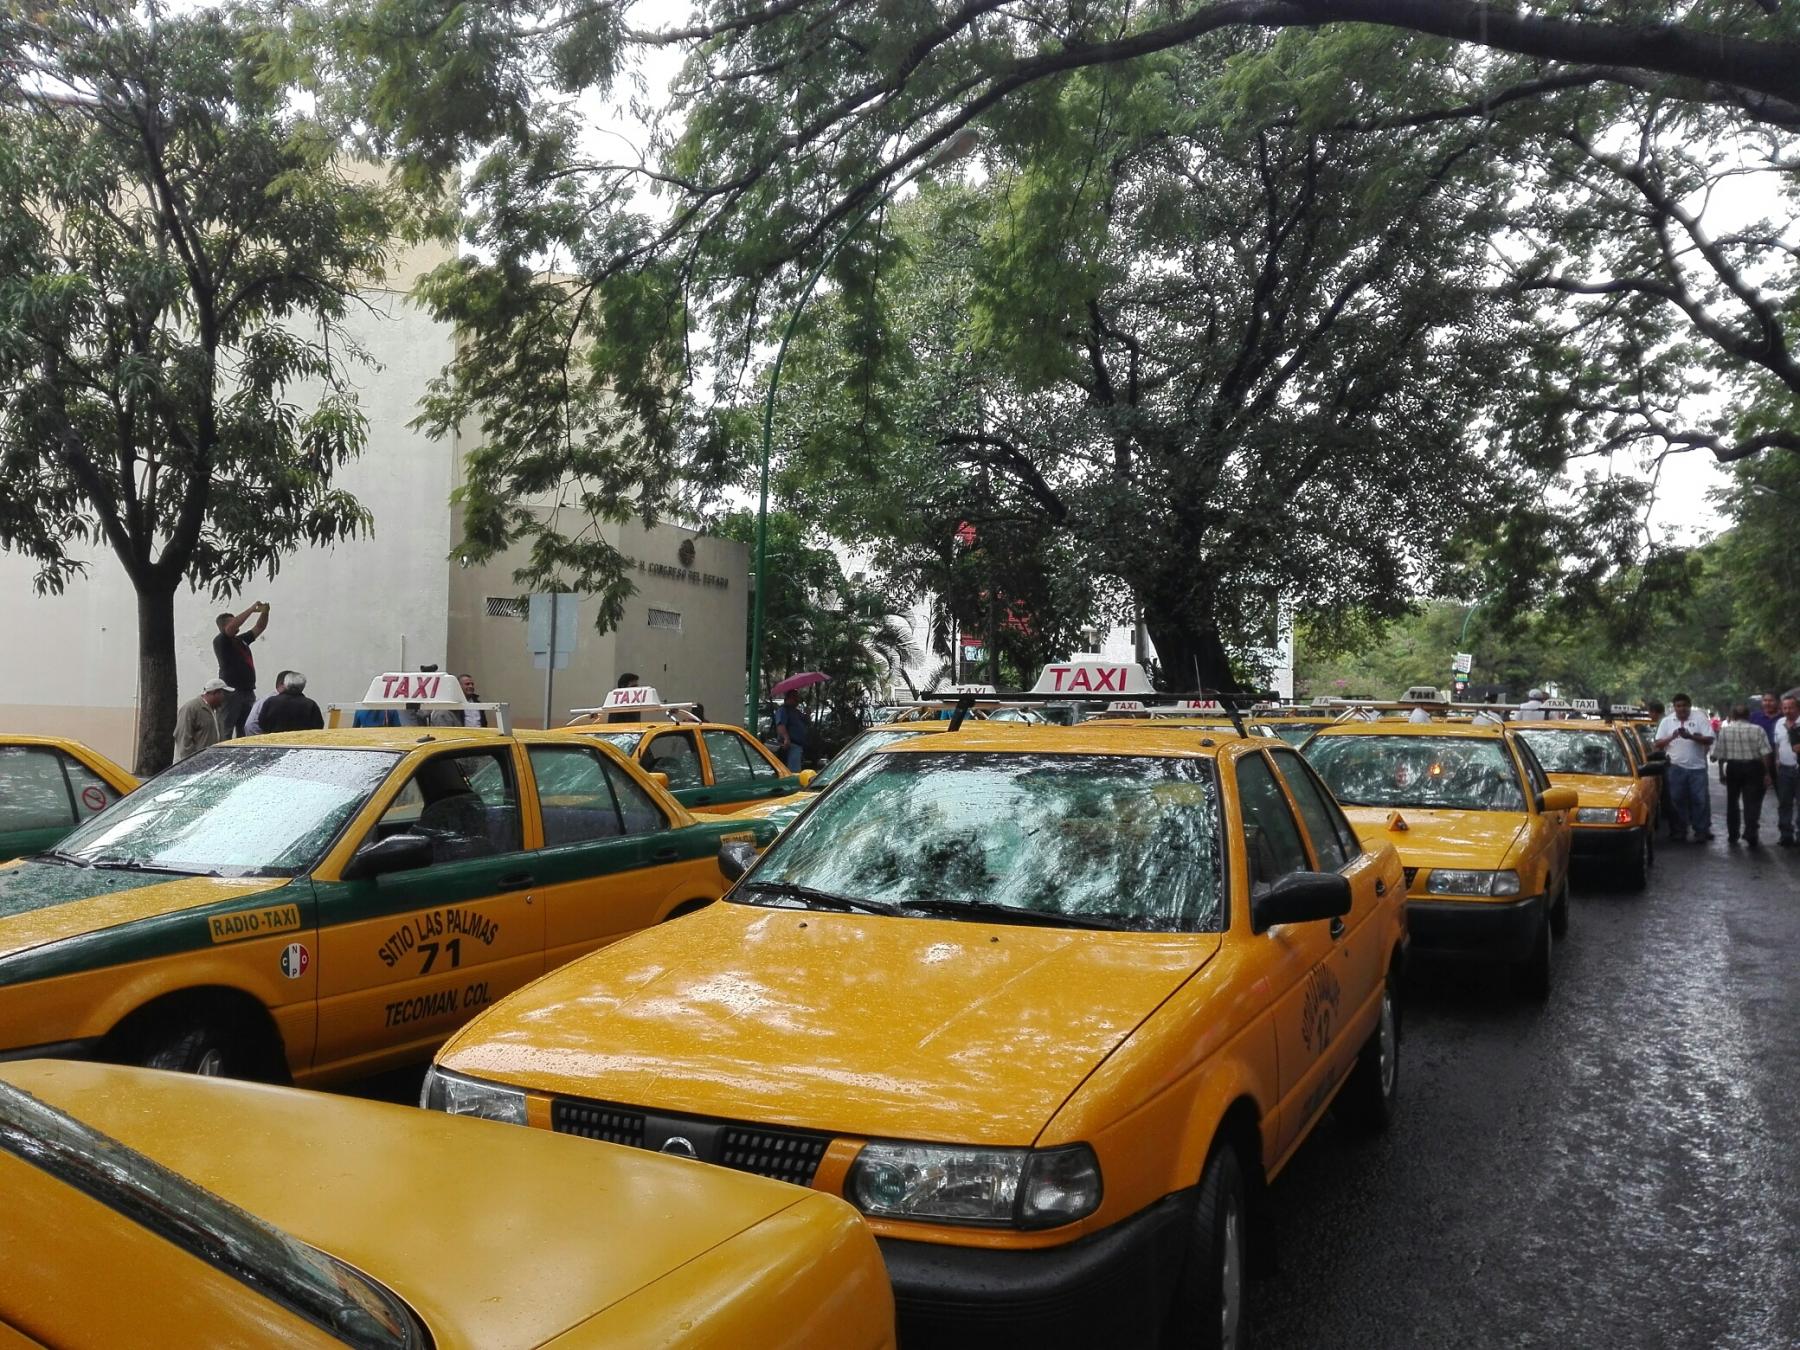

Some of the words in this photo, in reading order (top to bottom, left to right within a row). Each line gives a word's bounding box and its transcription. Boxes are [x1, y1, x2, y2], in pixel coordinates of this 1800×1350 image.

[382, 676, 440, 698] TAXI
[1049, 667, 1128, 692] TAXI
[613, 690, 647, 704] TAXI
[1409, 691, 1435, 699] TAXI
[1115, 702, 1138, 710] TAXI
[1186, 700, 1216, 709] TAXI
[1575, 700, 1595, 709] TAXI
[378, 925, 414, 967] SITIO
[415, 911, 443, 941] LAS
[446, 909, 498, 945] PALMAS
[417, 938, 461, 975] 71
[463, 982, 492, 1008] COL.
